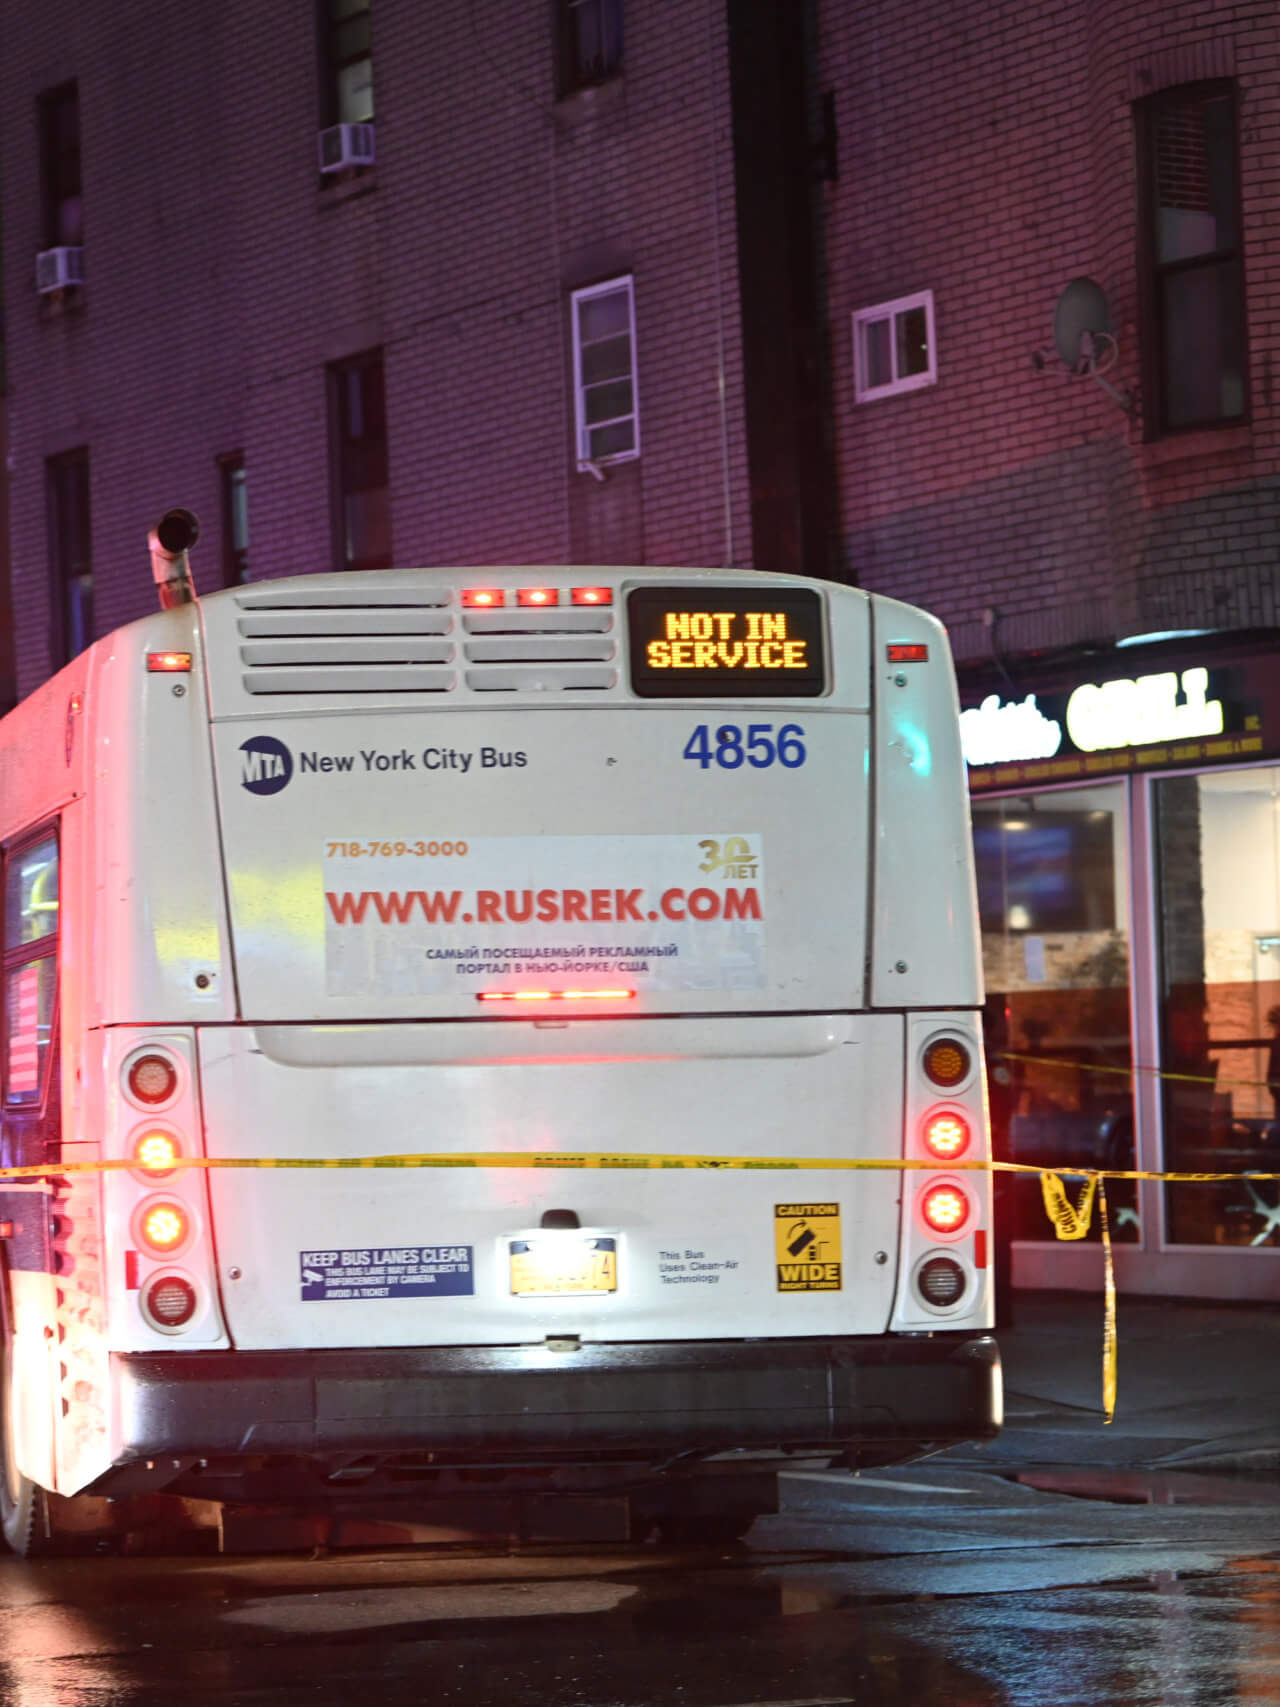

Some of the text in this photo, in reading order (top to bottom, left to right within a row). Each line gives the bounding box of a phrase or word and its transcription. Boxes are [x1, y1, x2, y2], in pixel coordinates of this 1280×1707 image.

[665, 612, 787, 640] NOT IN
[646, 640, 809, 669] SERVICE
[682, 723, 807, 770] 4856
[238, 746, 529, 785] MTA New York City Bus
[325, 840, 469, 859] 718-769-3000
[722, 864, 760, 880] ЛЕТ
[324, 887, 763, 926] WWW.RUSREK.COM
[425, 942, 679, 961] САМЫЙ ПОСЕЩАЕМЫЙ РЕКЛАМНЫЙ
[455, 962, 511, 974] ПОРТАЛ
[777, 1204, 838, 1217] CAUTION
[302, 1248, 469, 1268] KEEP BUS LANES CLEAR
[658, 1249, 705, 1261] This Bus
[658, 1259, 739, 1273] Uses Clean-Air
[780, 1264, 840, 1282] WIDE
[660, 1273, 720, 1285] Technology
